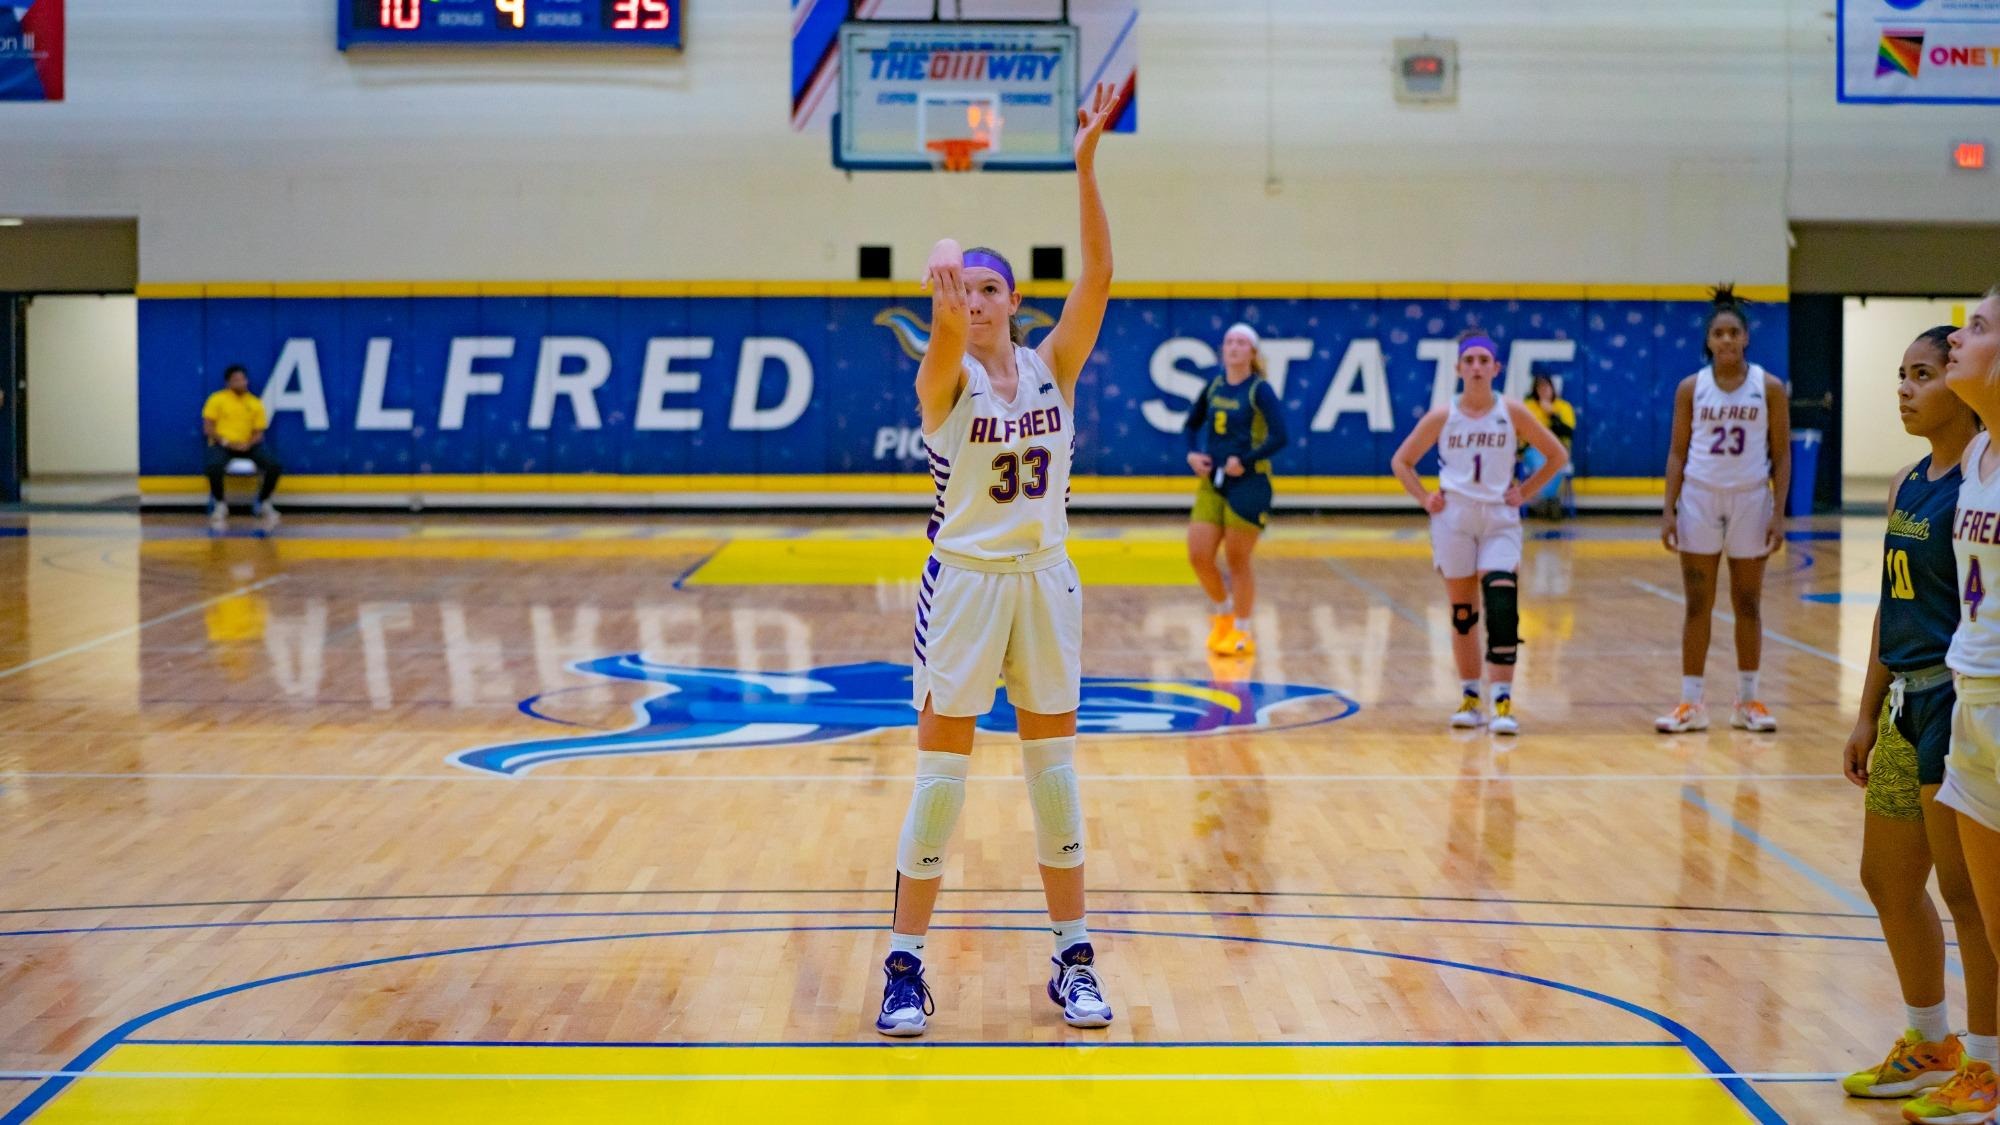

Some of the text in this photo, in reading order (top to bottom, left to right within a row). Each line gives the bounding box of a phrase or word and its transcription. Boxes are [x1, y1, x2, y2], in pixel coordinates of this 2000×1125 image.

[612, 0, 669, 29] 35
[870, 50, 929, 80] THE
[988, 54, 1061, 80] WAY
[264, 336, 814, 431] ALFRED
[969, 406, 1062, 443] ALFRED
[1700, 406, 1759, 421] ALFRED
[1447, 432, 1507, 449] ALFRED
[1710, 426, 1746, 456] 23
[989, 445, 1051, 504] 33
[1472, 453, 1482, 483] 1
[1886, 547, 1916, 600] 10
[1963, 554, 1986, 622] 4
